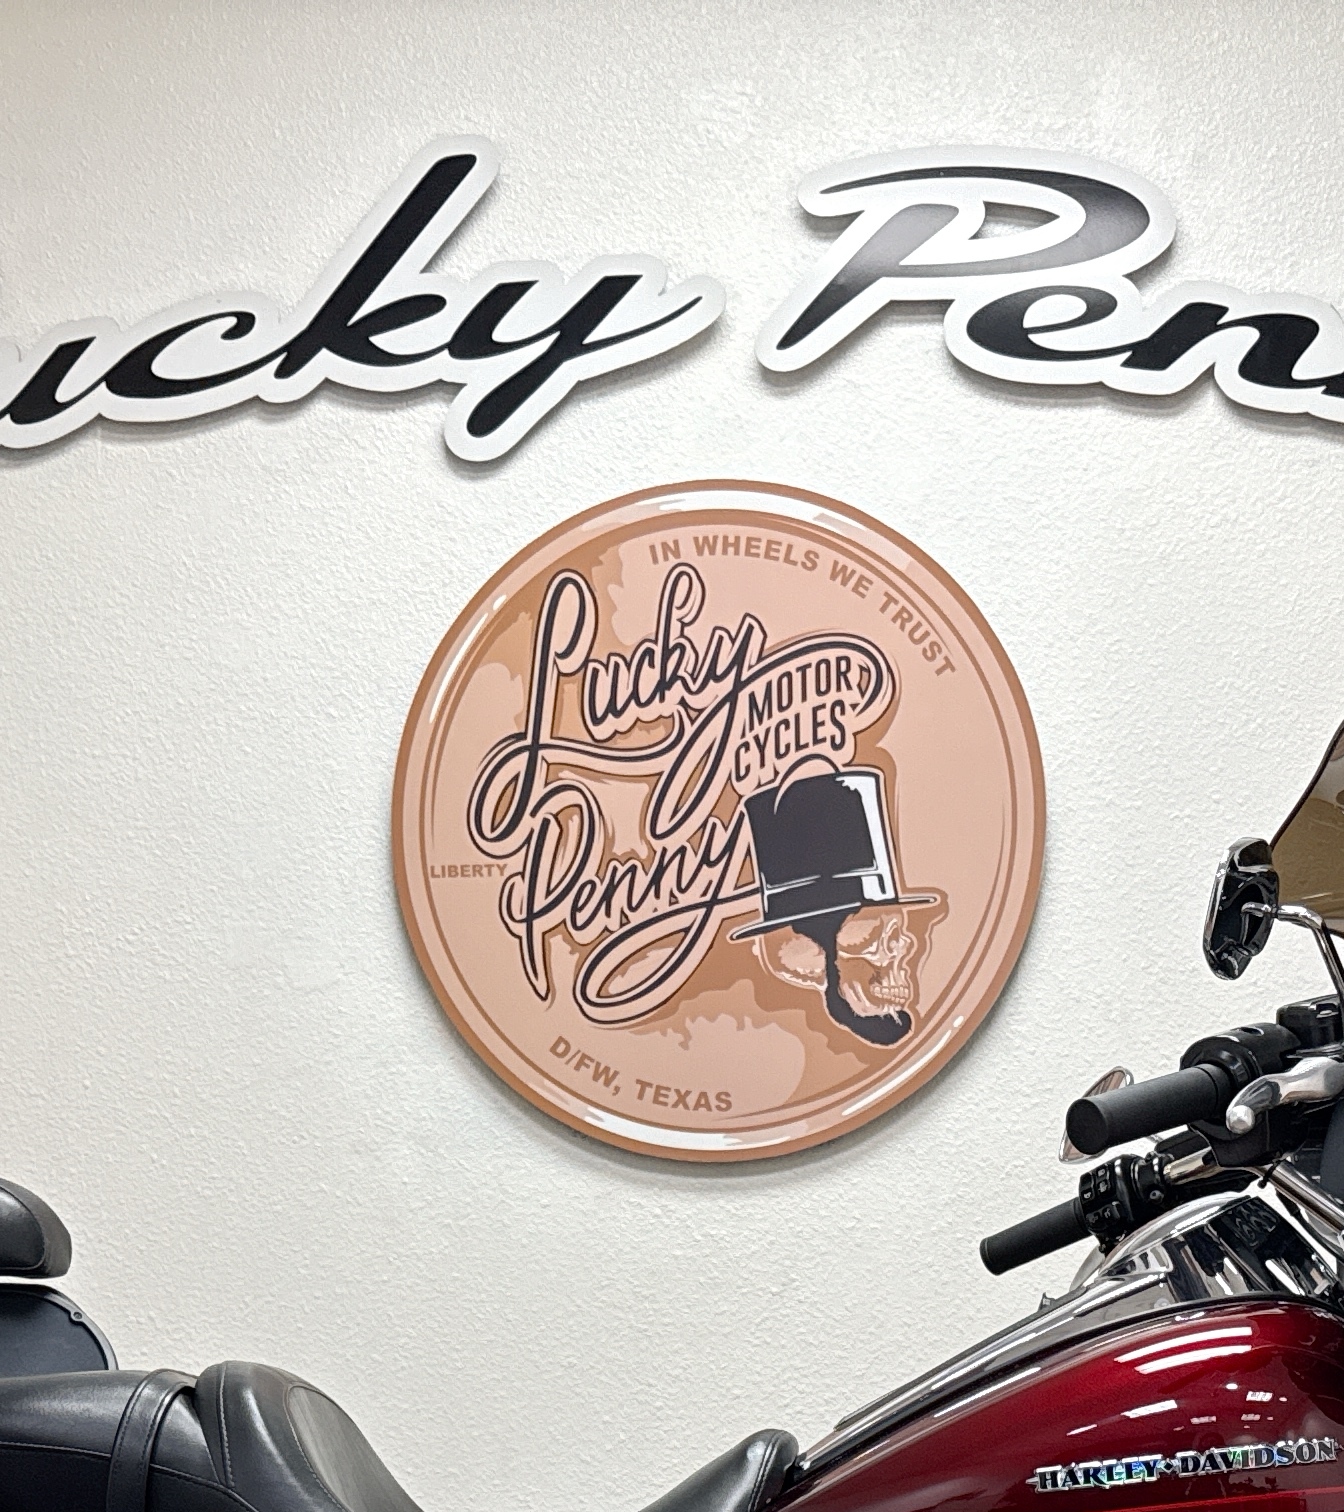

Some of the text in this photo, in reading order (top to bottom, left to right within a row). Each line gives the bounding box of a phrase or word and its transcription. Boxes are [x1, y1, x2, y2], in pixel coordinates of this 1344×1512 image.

[649, 534, 957, 678] IN WHEELS WE TRUST
[474, 569, 884, 843] Lucky
[748, 655, 854, 734] MOTOR
[734, 699, 847, 783] CYCLES
[430, 862, 508, 879] LIBERTY
[505, 784, 763, 1010] Penny
[549, 1035, 734, 1113] D/FW, TEXAS
